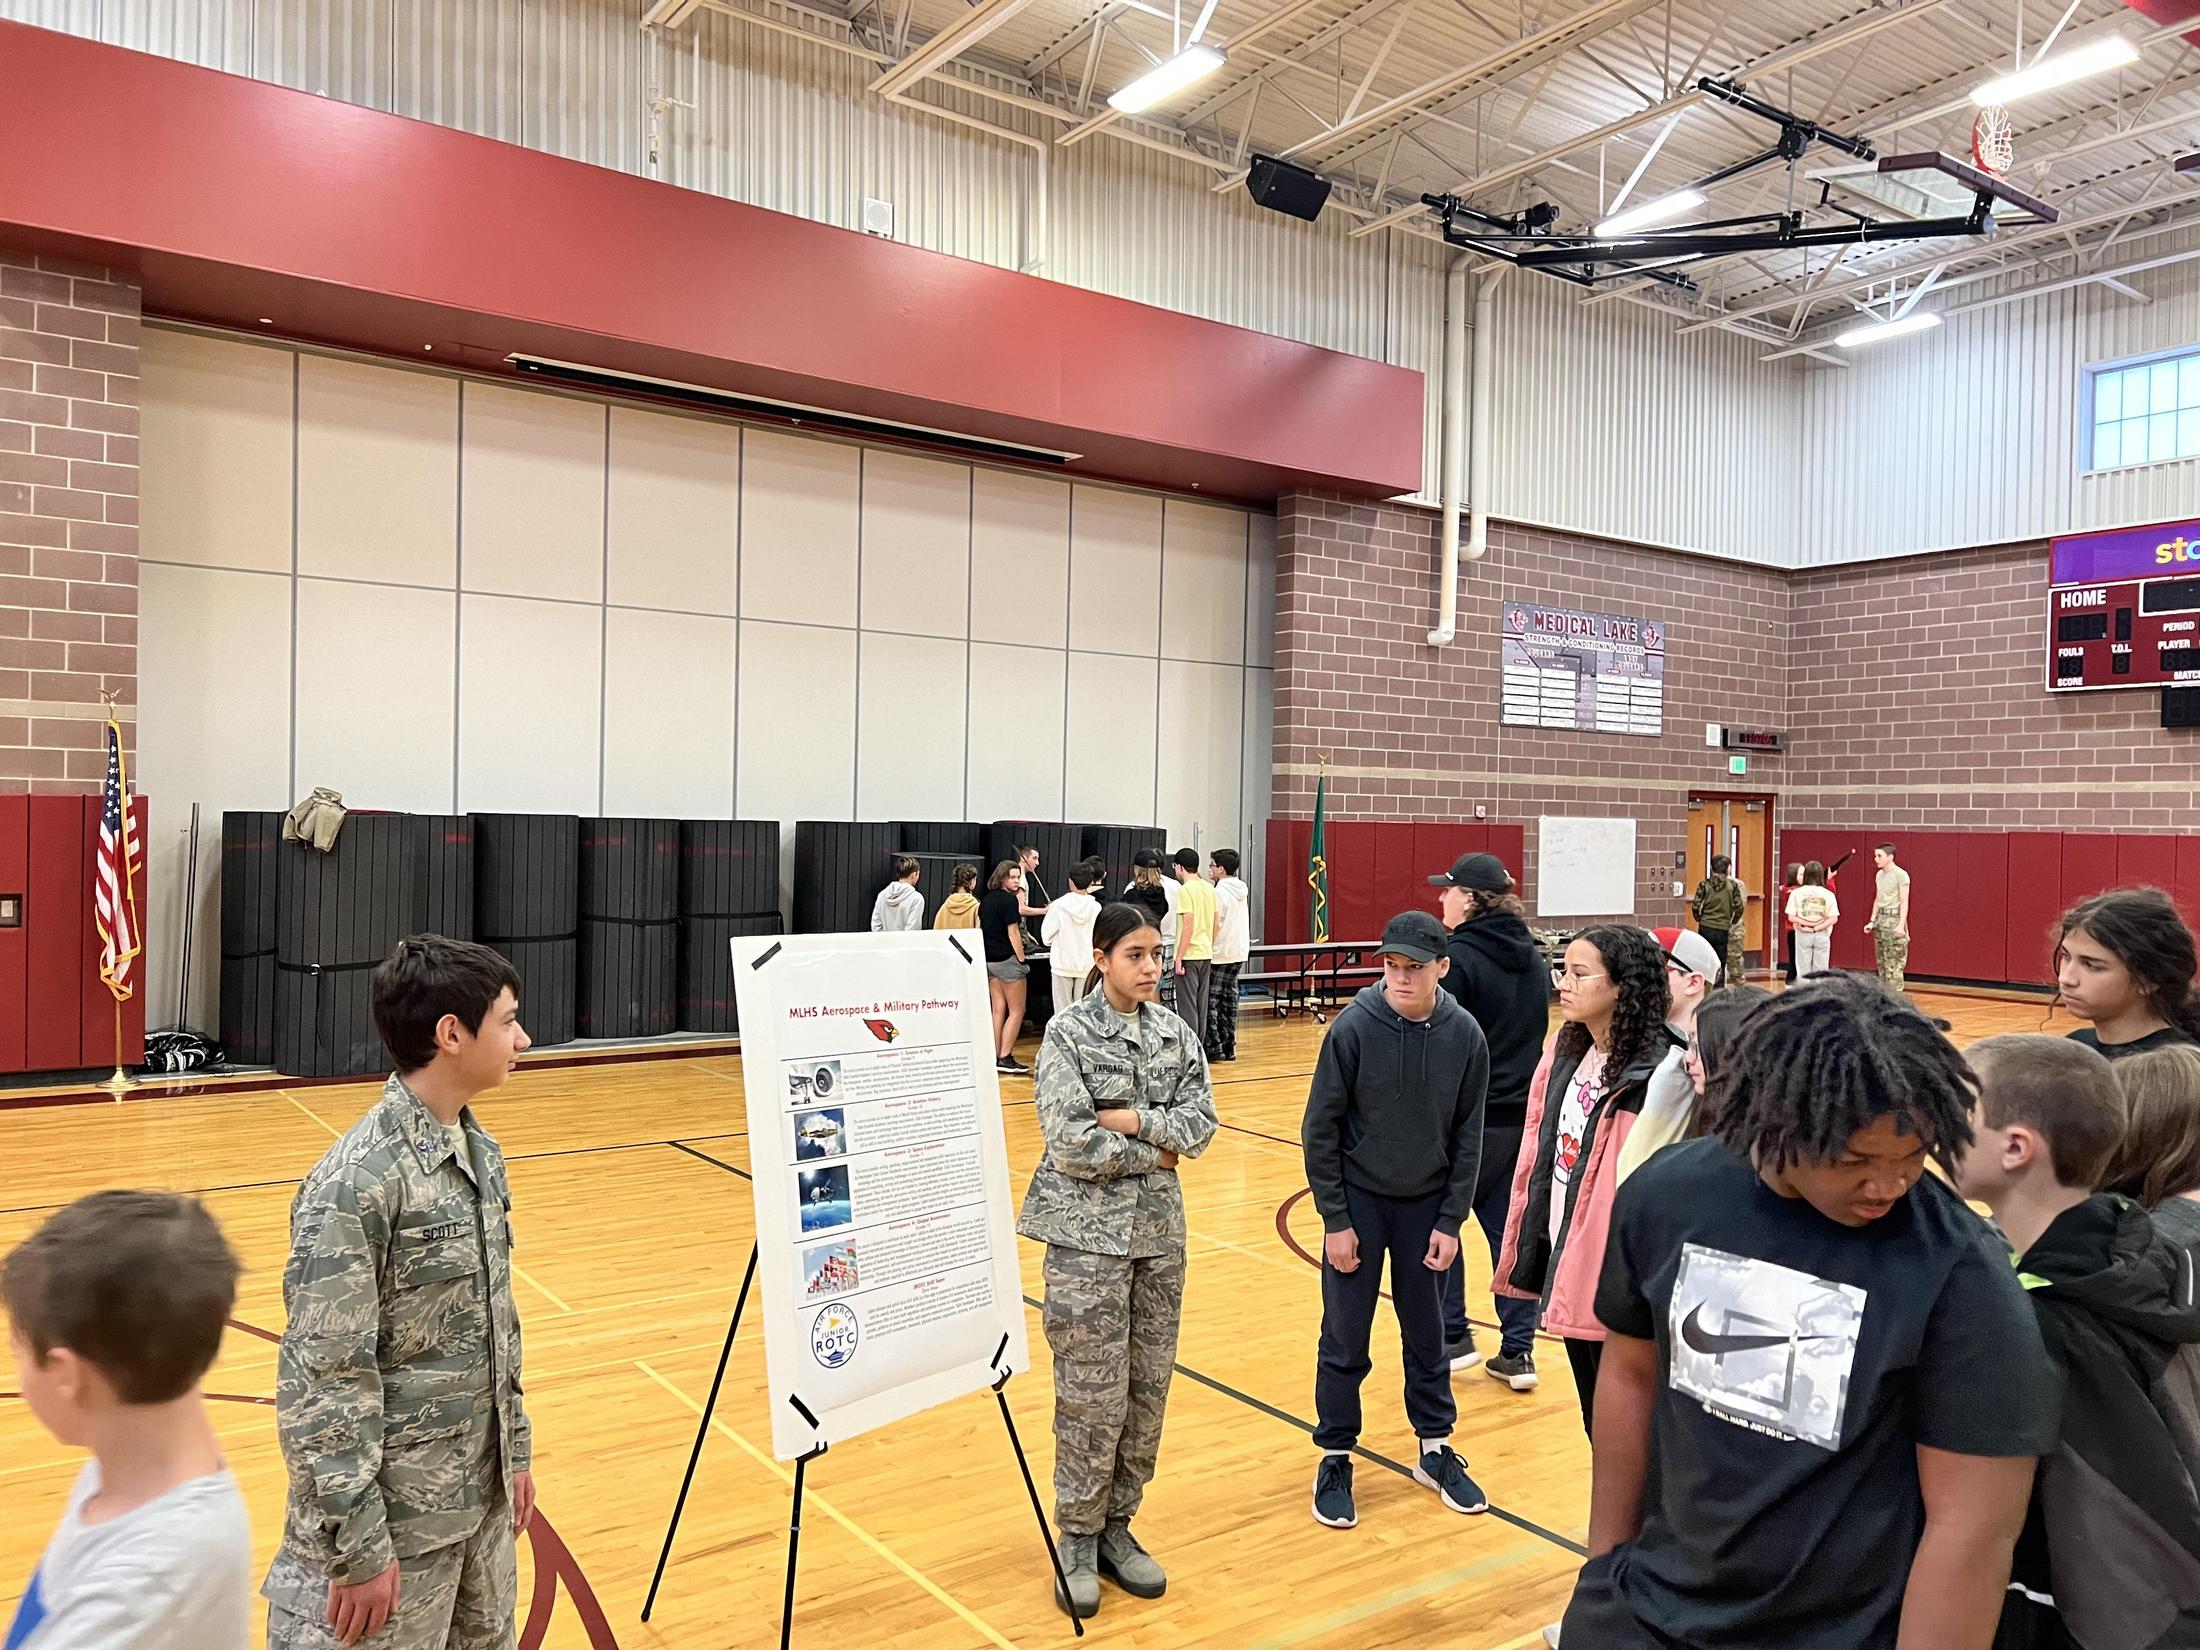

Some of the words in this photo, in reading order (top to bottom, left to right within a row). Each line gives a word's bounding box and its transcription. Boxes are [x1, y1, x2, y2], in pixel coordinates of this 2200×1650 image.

[2061, 590, 2106, 608] HOME
[1534, 611, 1597, 637] MEDICAL
[1603, 620, 1638, 642] LAKE
[2163, 621, 2195, 632] PERIOD
[1524, 634, 1559, 645] STRENGTH
[1568, 640, 1615, 651] CONDITIONING
[1616, 645, 1644, 654] RECORDS
[2058, 647, 2084, 657] FOULS
[2111, 644, 2132, 653] T.O.L.
[2158, 639, 2190, 650] PLAYER
[2057, 677, 2083, 686] SCORE
[2174, 670, 2200, 680] MATC
[790, 1007, 817, 1018] MLHS
[822, 1006, 870, 1017] Aerospace
[873, 1003, 880, 1013] &
[884, 1000, 920, 1013] Military
[922, 998, 959, 1010] Pathway
[423, 1222, 459, 1242] SCOTT
[815, 1314, 825, 1333] AIR
[828, 1306, 855, 1323] FORCE
[822, 1326, 848, 1339] JUNIOR
[816, 1332, 855, 1353] ROTC
[1750, 1422, 1765, 1433] JUST
[1766, 1427, 1775, 1437] DO
